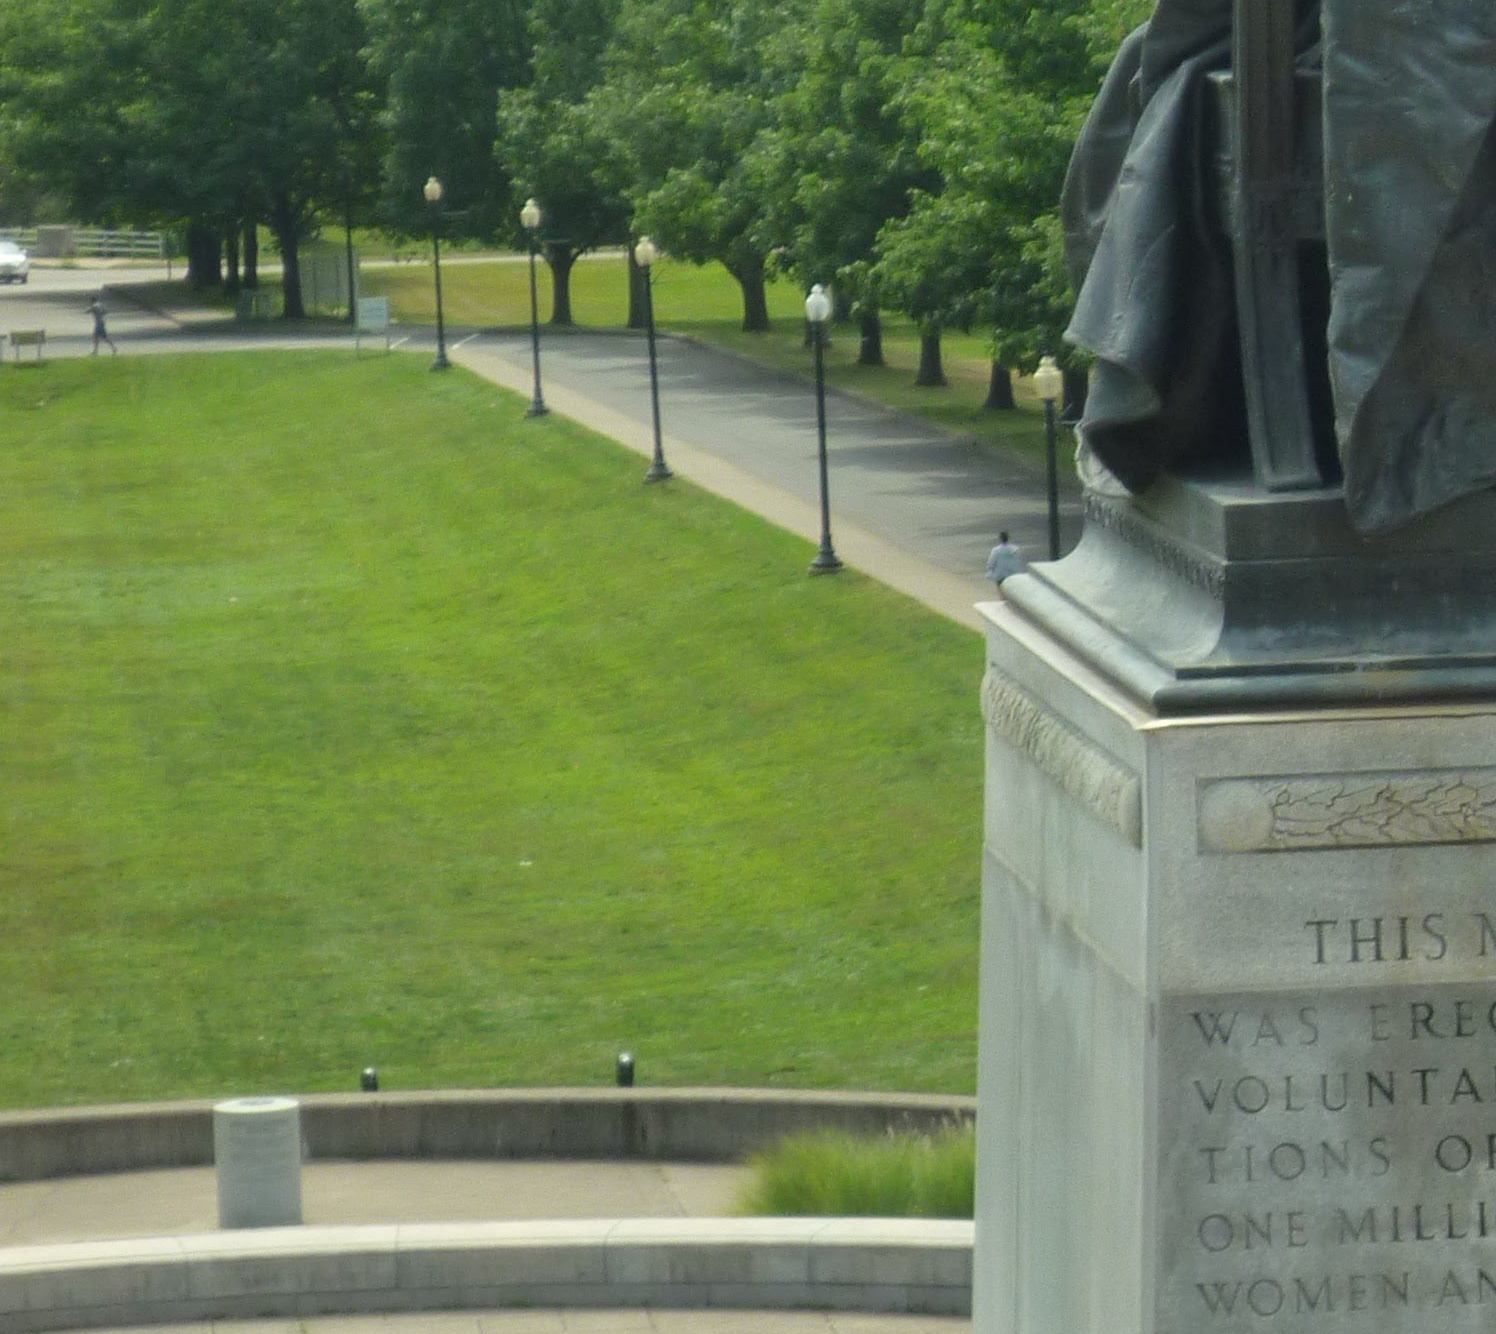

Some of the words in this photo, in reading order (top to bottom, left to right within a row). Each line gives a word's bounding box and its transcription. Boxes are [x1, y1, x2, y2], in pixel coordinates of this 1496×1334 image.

[1304, 913, 1447, 964] THIS
[1190, 1005, 1319, 1047] WAS
[1199, 1137, 1391, 1184] TIONS
[1198, 1211, 1308, 1252] ONE
[1196, 1271, 1410, 1317] WOMEN
